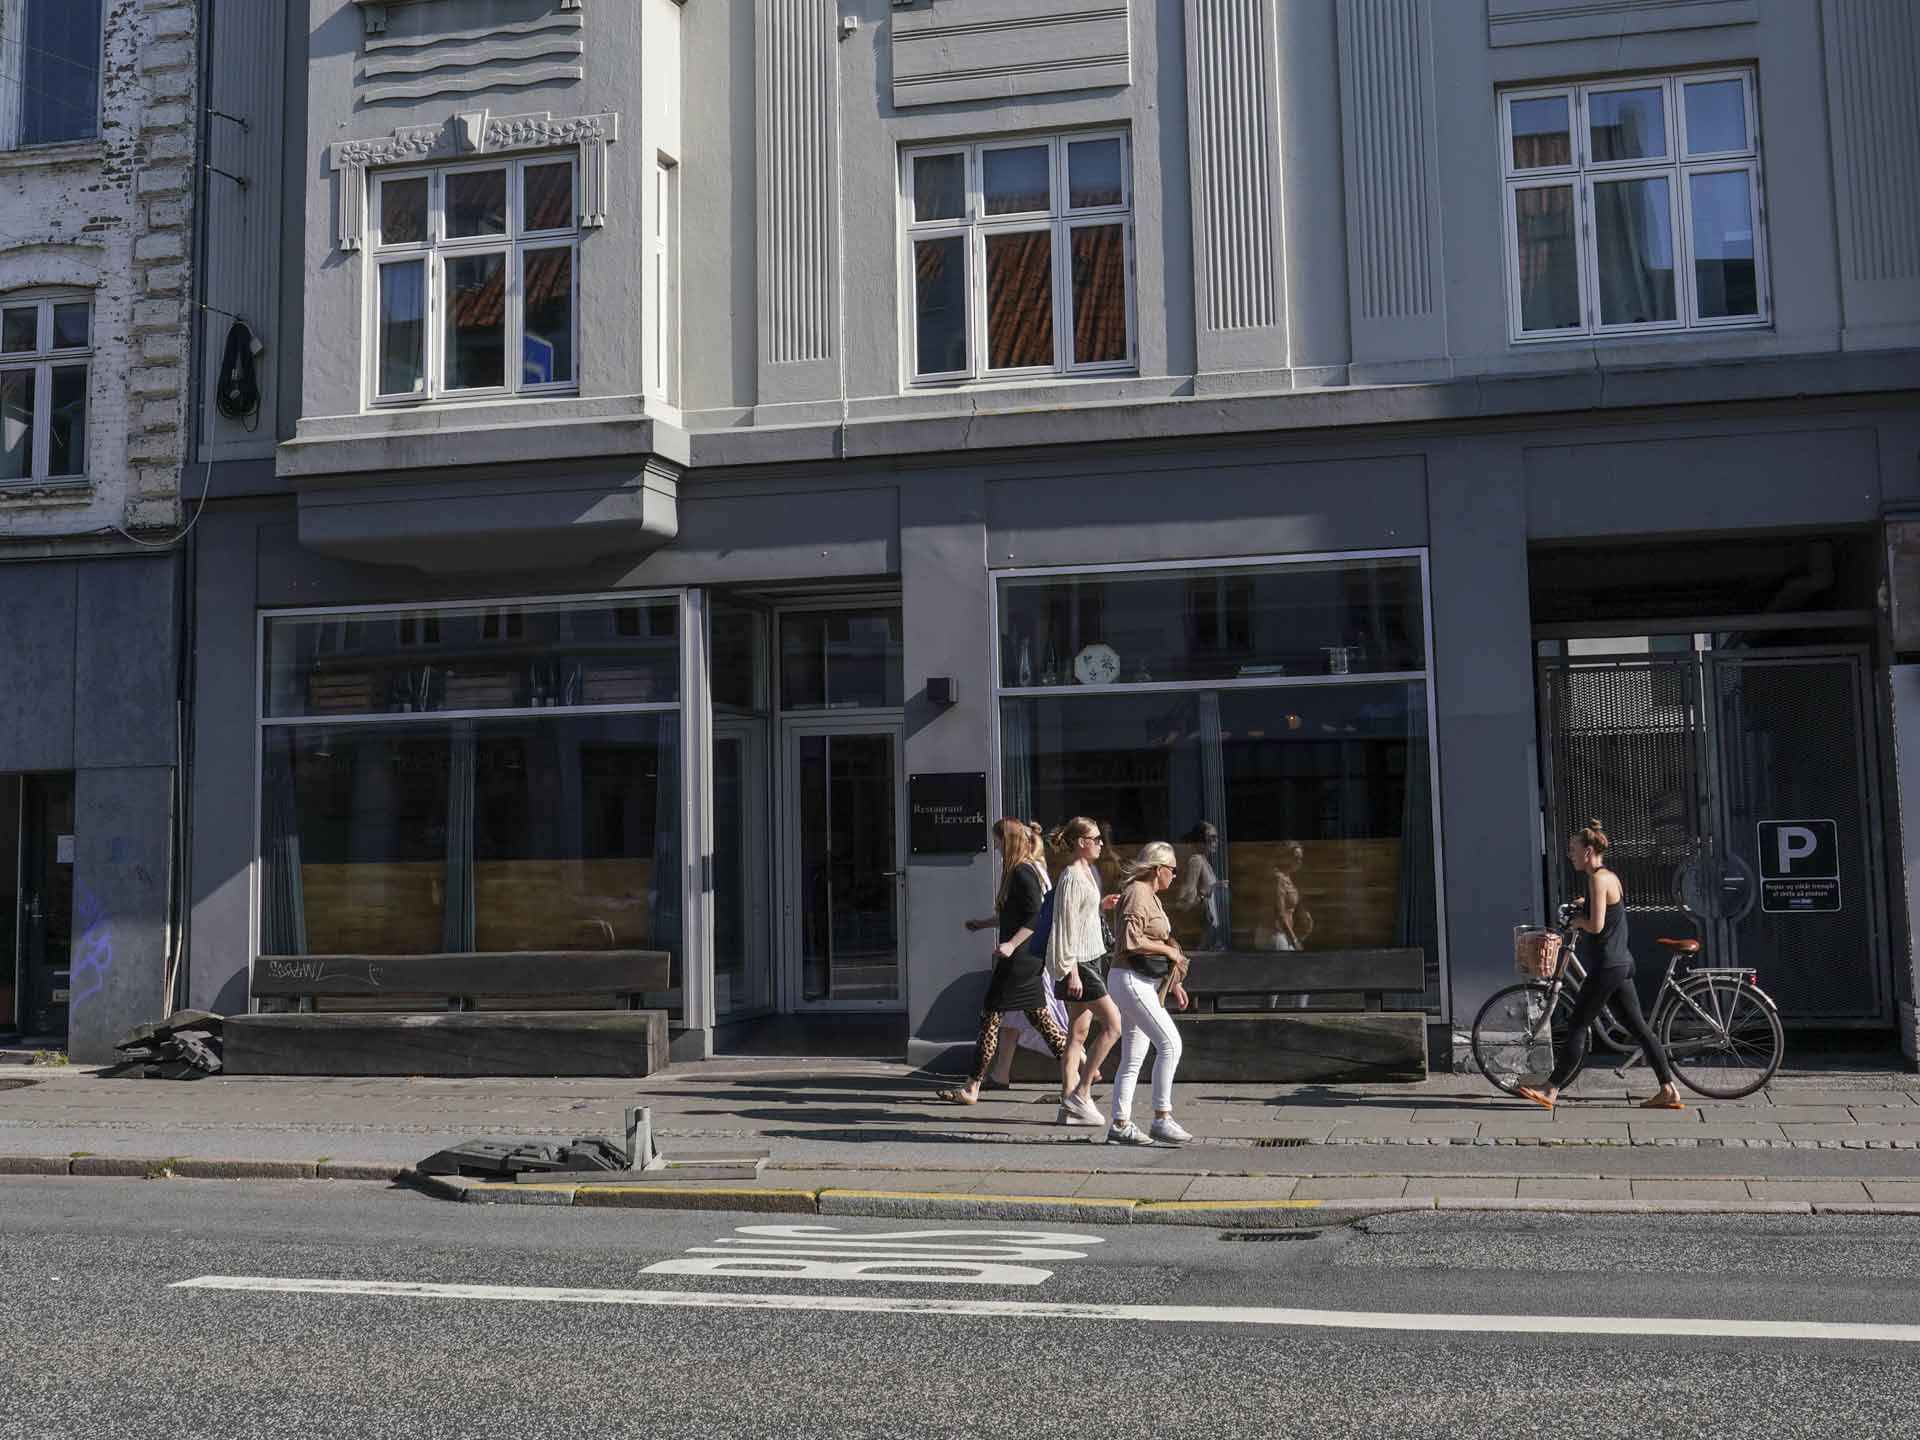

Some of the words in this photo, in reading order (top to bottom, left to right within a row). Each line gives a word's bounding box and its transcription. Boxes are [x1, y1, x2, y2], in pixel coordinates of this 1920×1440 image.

[913, 803, 962, 814] Restaurant
[1777, 827, 1817, 873] P
[638, 1225, 1105, 1285] BUS
